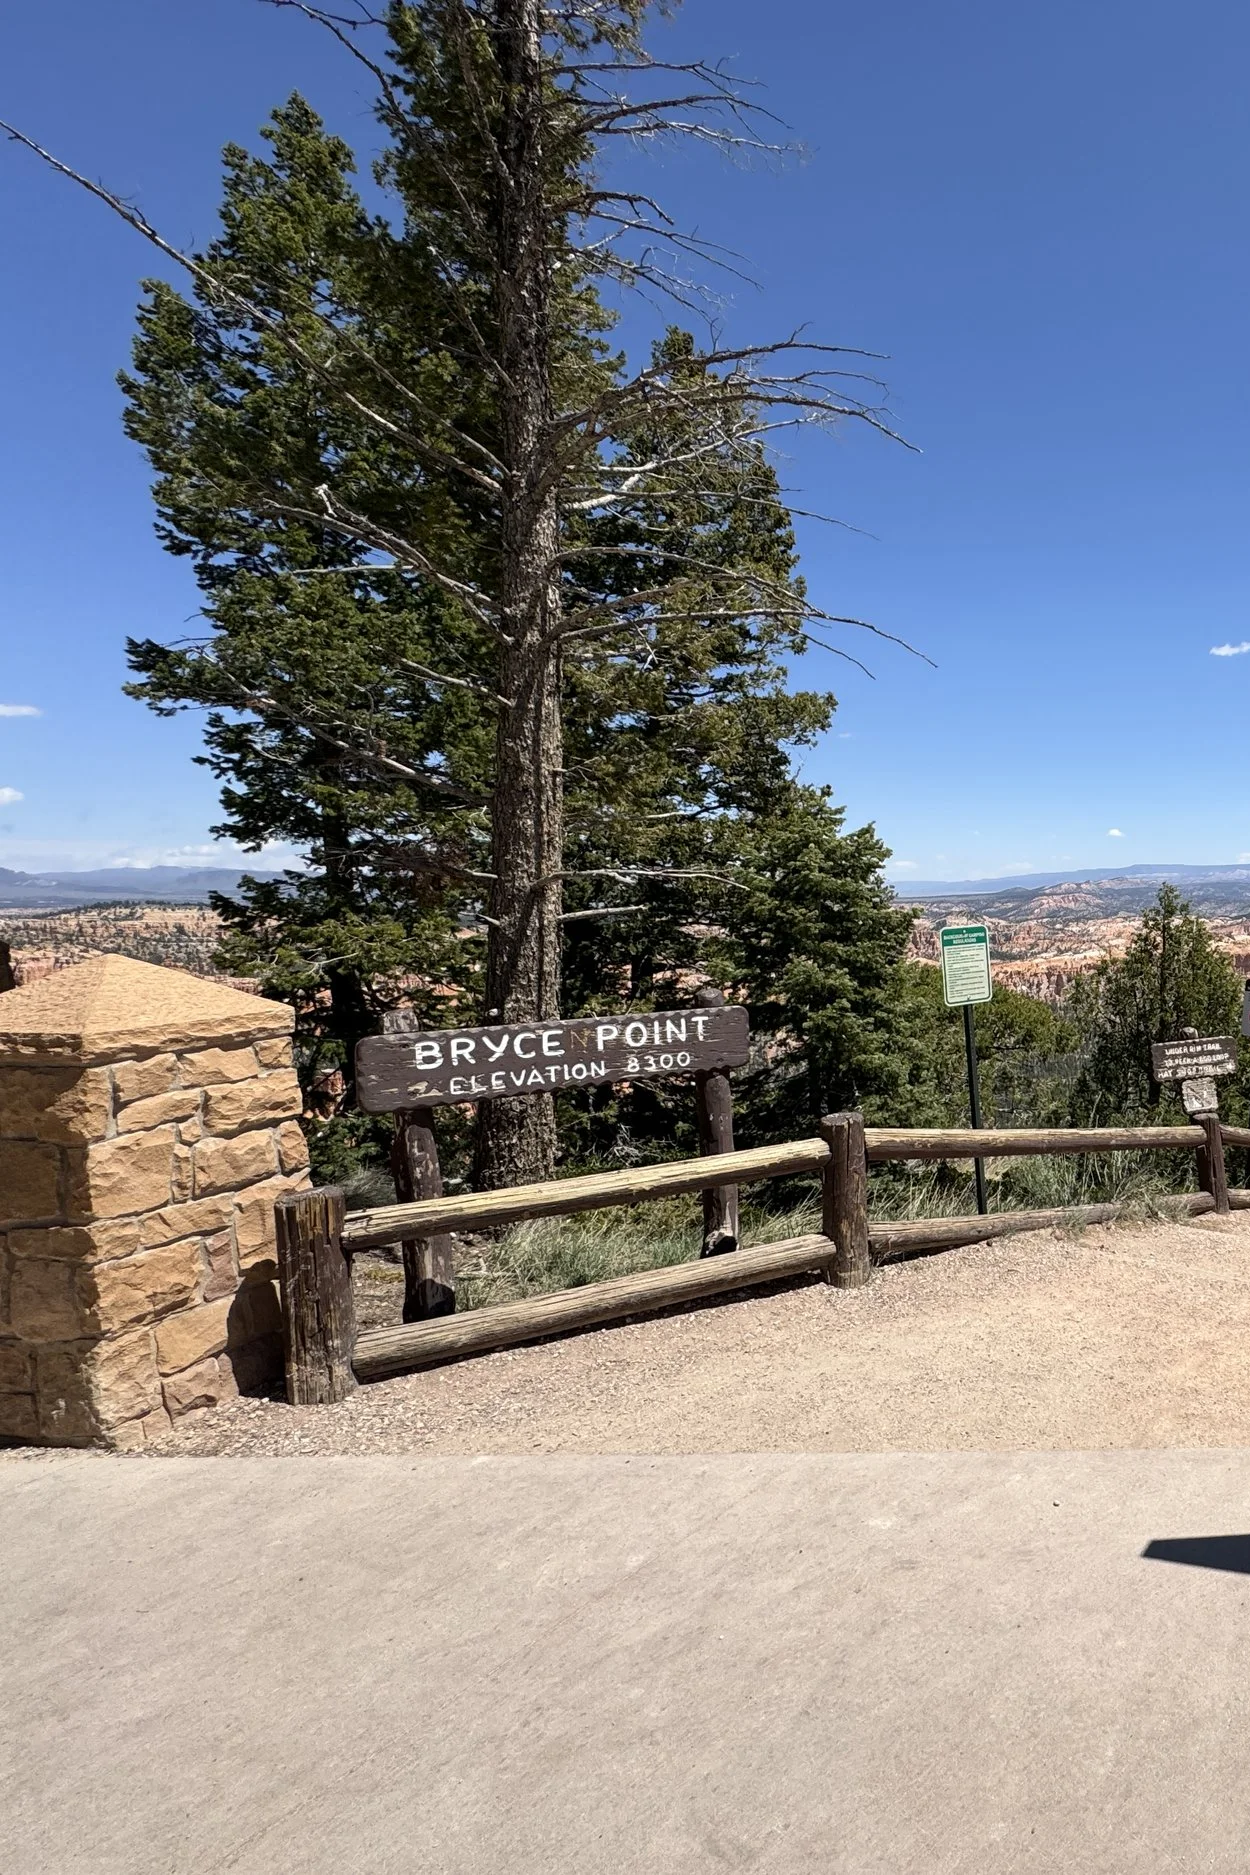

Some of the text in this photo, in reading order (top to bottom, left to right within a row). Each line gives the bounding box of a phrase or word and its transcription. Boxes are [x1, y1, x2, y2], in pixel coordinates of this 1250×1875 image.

[415, 1029, 566, 1070] BRYCE
[596, 1016, 709, 1052] POINT
[449, 1051, 692, 1095] ELEVATION 8300
